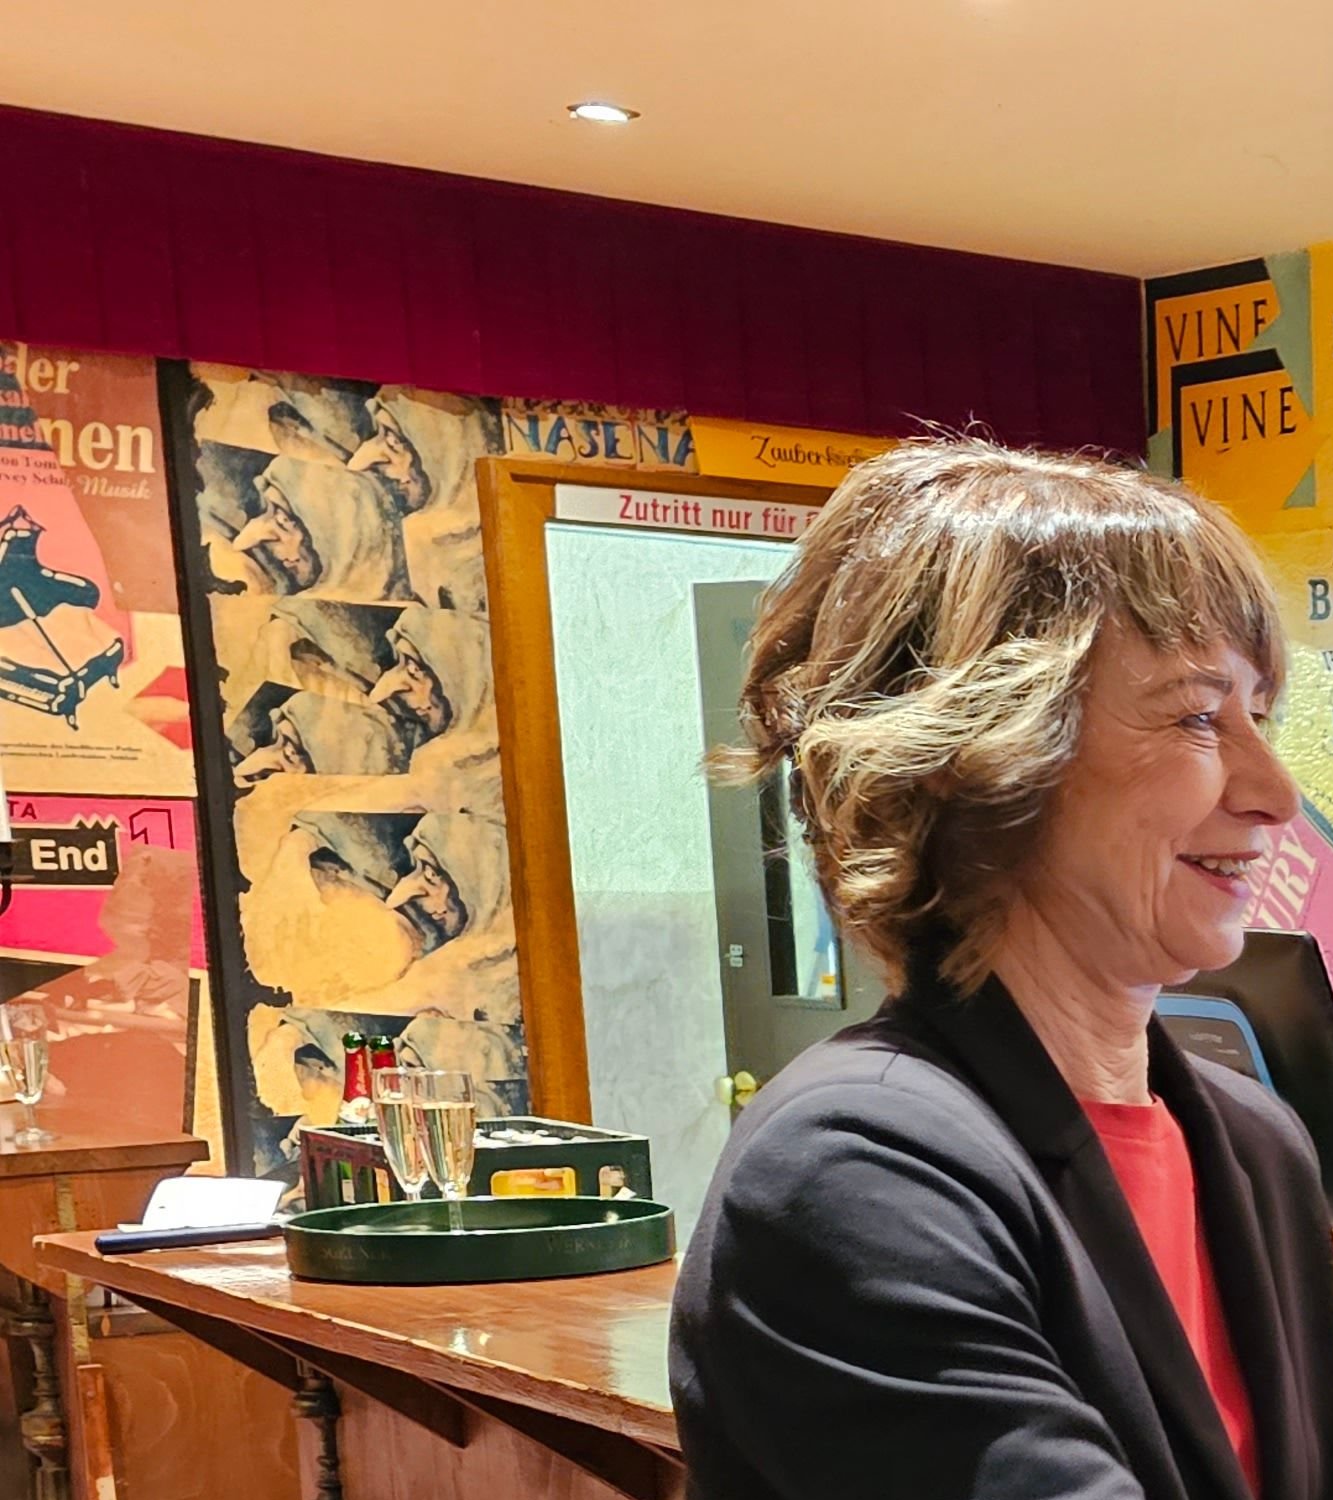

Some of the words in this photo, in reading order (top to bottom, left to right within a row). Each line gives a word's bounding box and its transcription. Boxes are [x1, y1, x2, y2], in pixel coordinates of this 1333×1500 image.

[1190, 385, 1297, 447] VINE
[505, 412, 633, 463] NASE
[77, 474, 152, 499] Musik
[619, 494, 703, 527] Zutritt
[711, 507, 753, 531] nur
[761, 506, 797, 534] für
[30, 838, 108, 872] End
